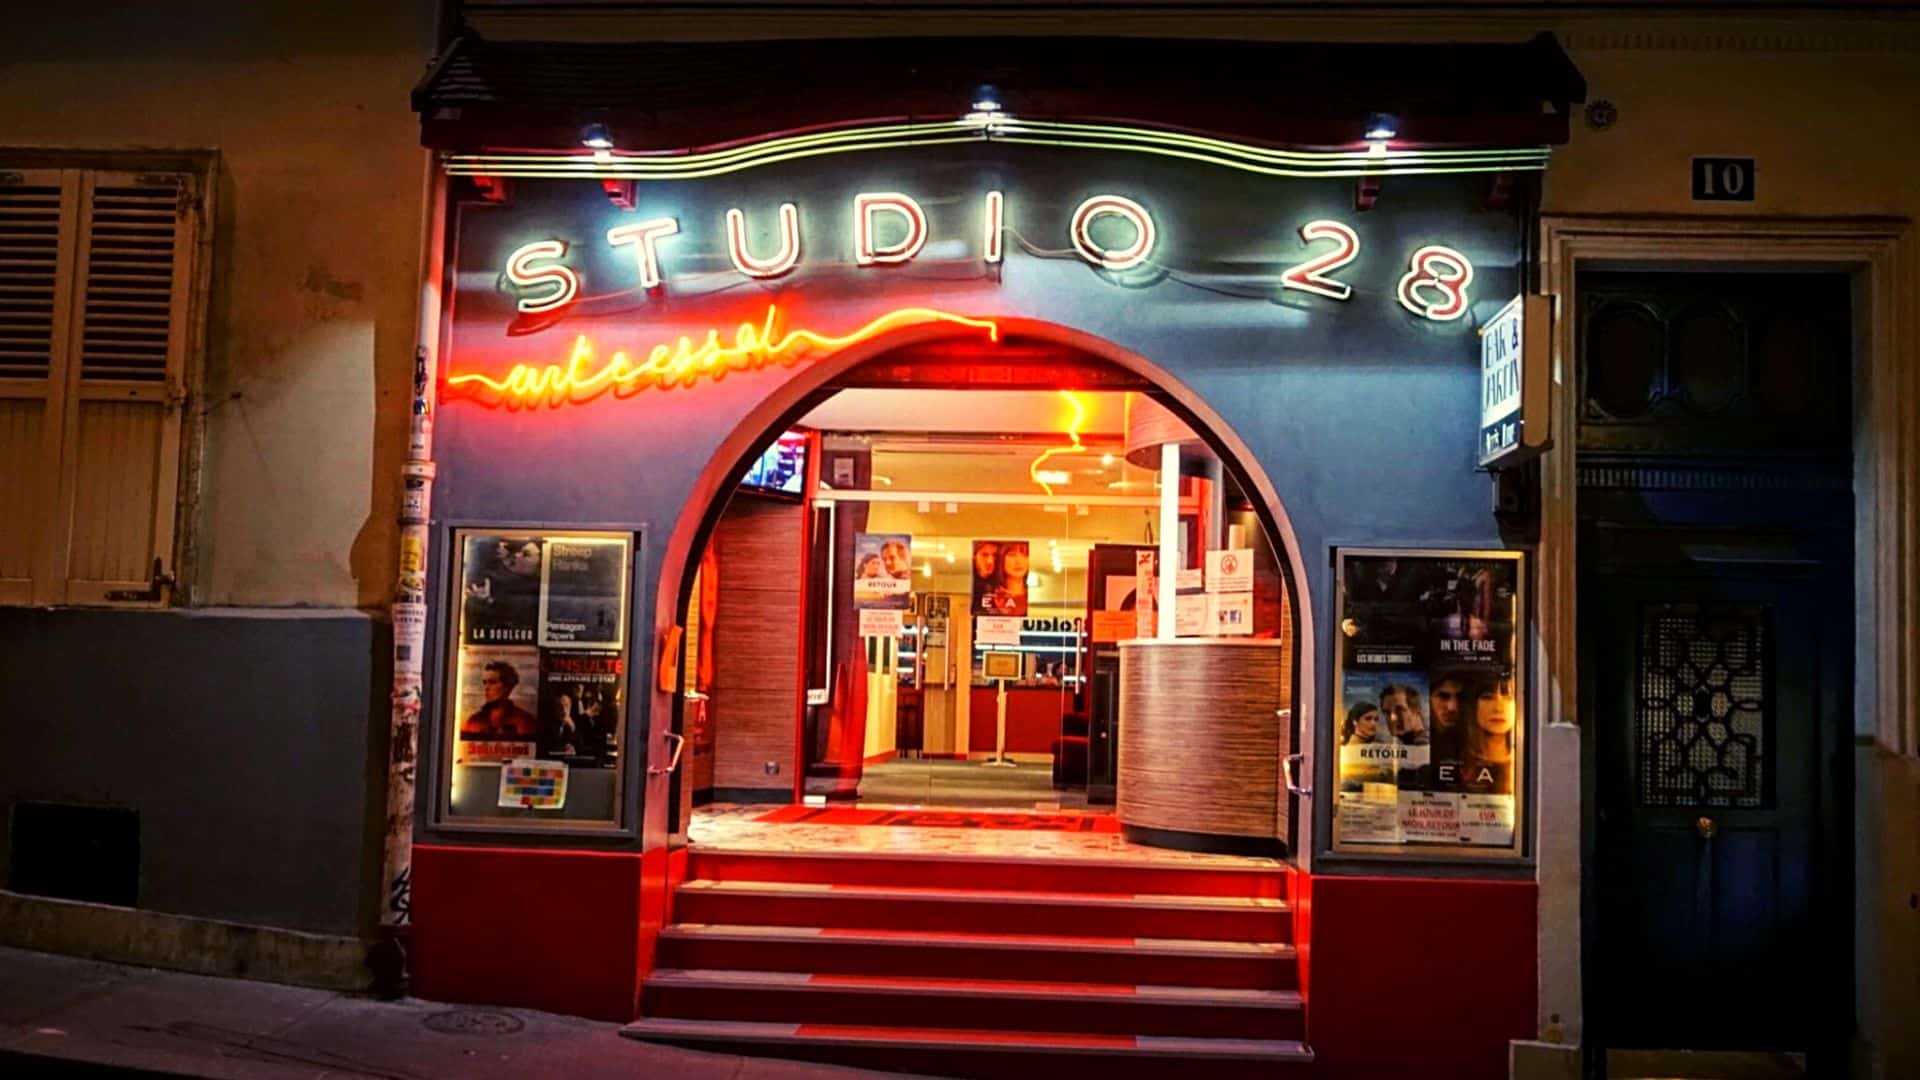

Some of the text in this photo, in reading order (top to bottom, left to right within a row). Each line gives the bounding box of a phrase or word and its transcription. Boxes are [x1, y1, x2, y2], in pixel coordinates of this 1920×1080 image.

[1703, 163, 1744, 194] 10
[504, 190, 1474, 321] STUDIO 28
[981, 596, 1017, 608] EVA
[1023, 616, 1072, 632] UDIO
[472, 627, 485, 640] LA
[1440, 639, 1497, 652] IN THE FADE
[1360, 748, 1408, 759] RETOUR
[1439, 765, 1495, 784] EVA
